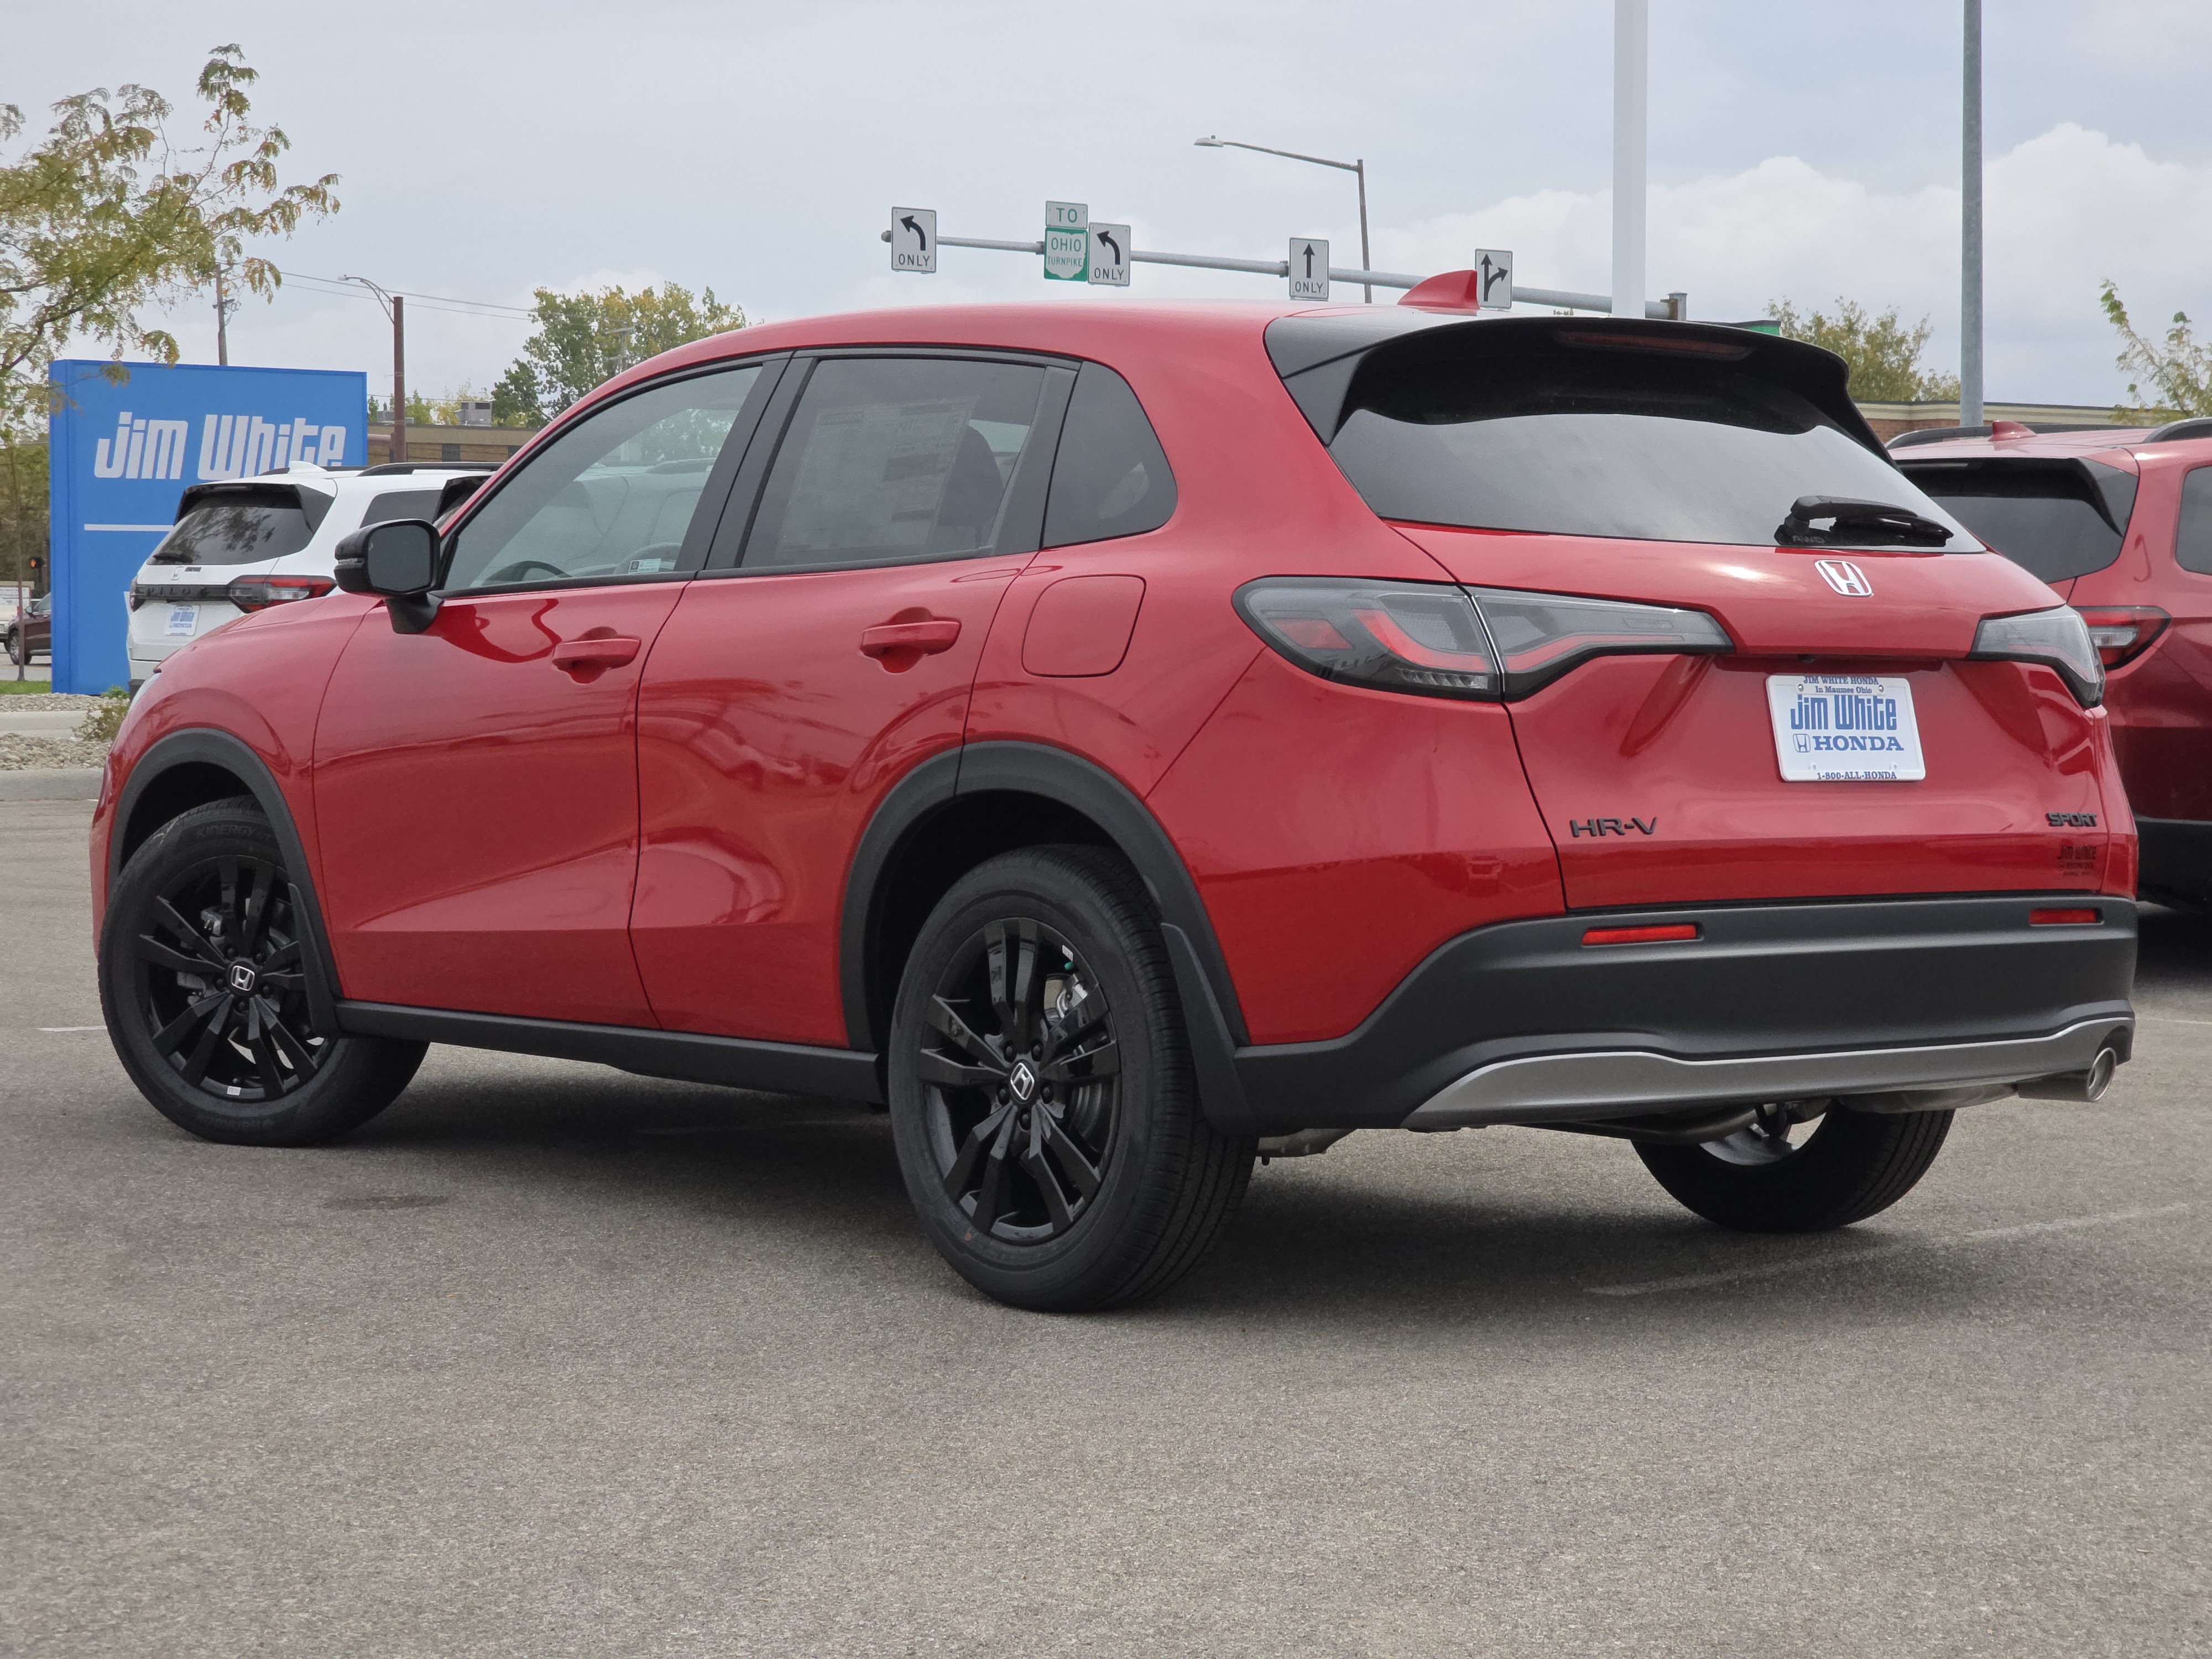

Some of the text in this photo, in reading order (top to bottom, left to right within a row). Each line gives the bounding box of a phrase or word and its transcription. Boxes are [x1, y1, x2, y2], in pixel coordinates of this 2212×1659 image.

[1056, 207, 1078, 223] TO
[1051, 237, 1082, 252] OHIO
[898, 253, 931, 267] ONLY
[1047, 255, 1083, 267] TURNPIKE
[1094, 267, 1125, 280] ONLY
[1295, 281, 1324, 294] ONLY
[94, 411, 347, 481] Jim White
[1820, 676, 1848, 684] WHITE
[1850, 676, 1879, 685] HONDA
[1791, 694, 1897, 731] Jim White
[1813, 735, 1905, 752] HONDA
[1817, 771, 1897, 780] 1-800-ALL-HONDA
[2046, 812, 2098, 827] SPORT
[1569, 817, 1658, 838] HR-V
